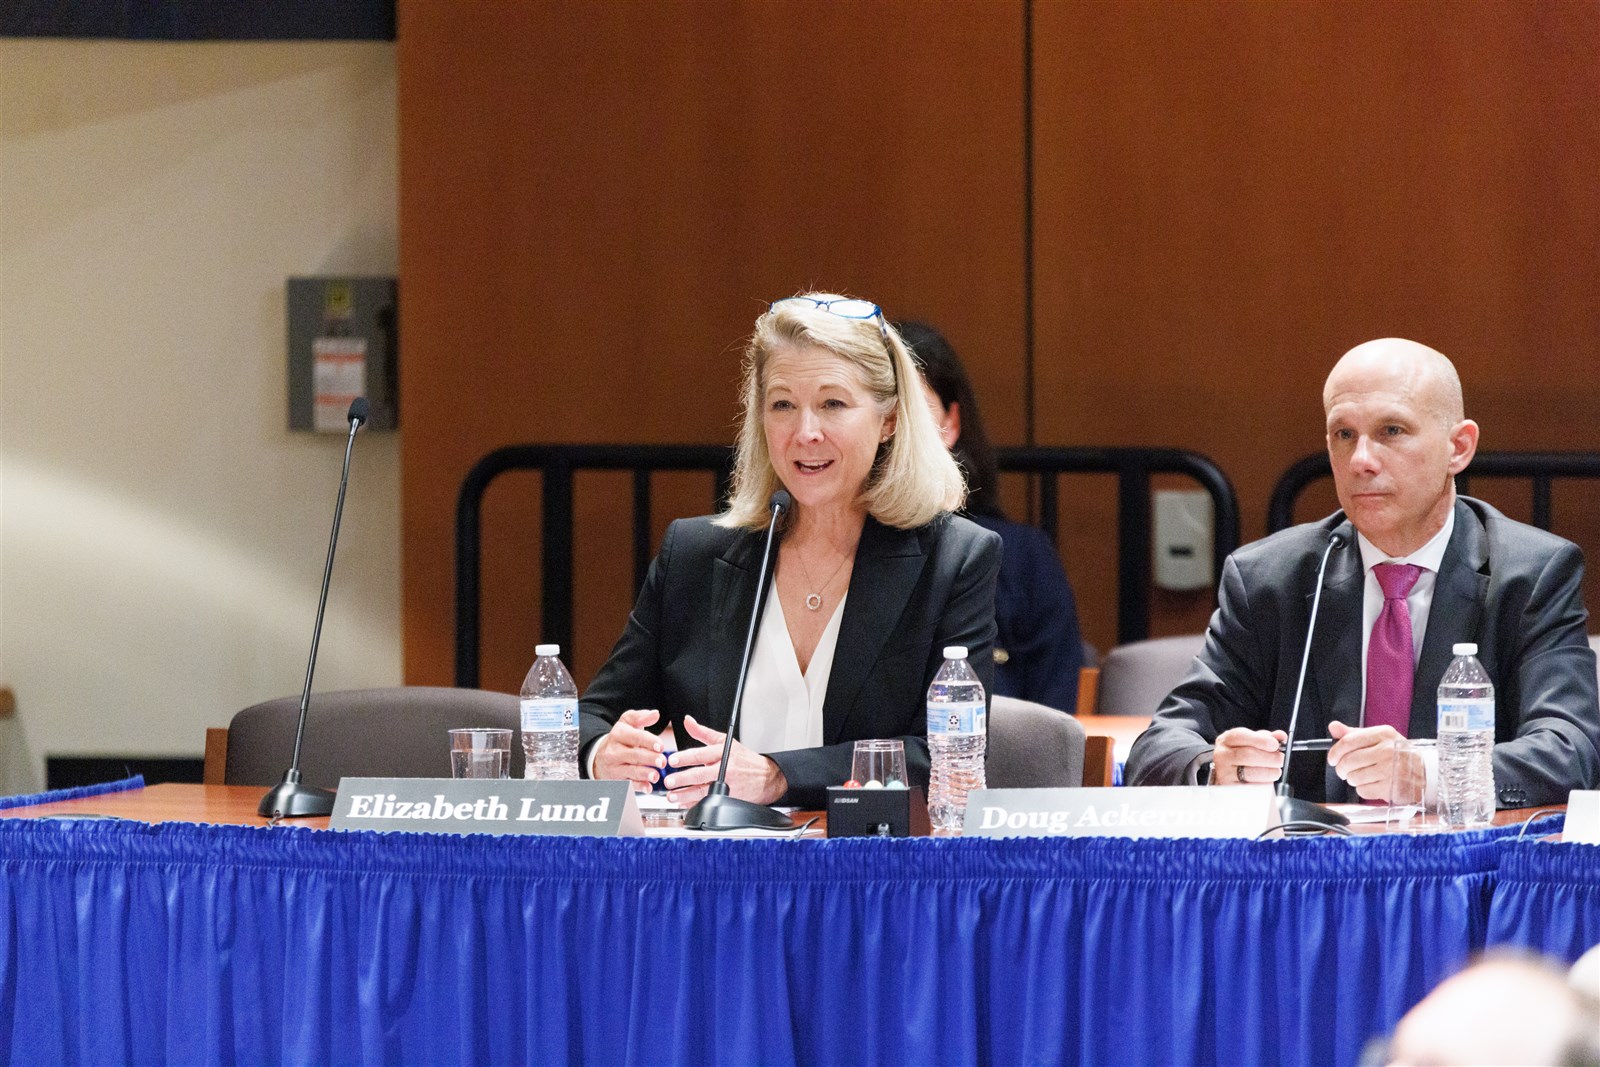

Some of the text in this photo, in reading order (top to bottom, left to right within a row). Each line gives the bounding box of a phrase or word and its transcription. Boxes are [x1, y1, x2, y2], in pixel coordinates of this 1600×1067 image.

[347, 795, 609, 822] Elizabeth Lund
[980, 803, 1249, 834] Doug Ackerman
